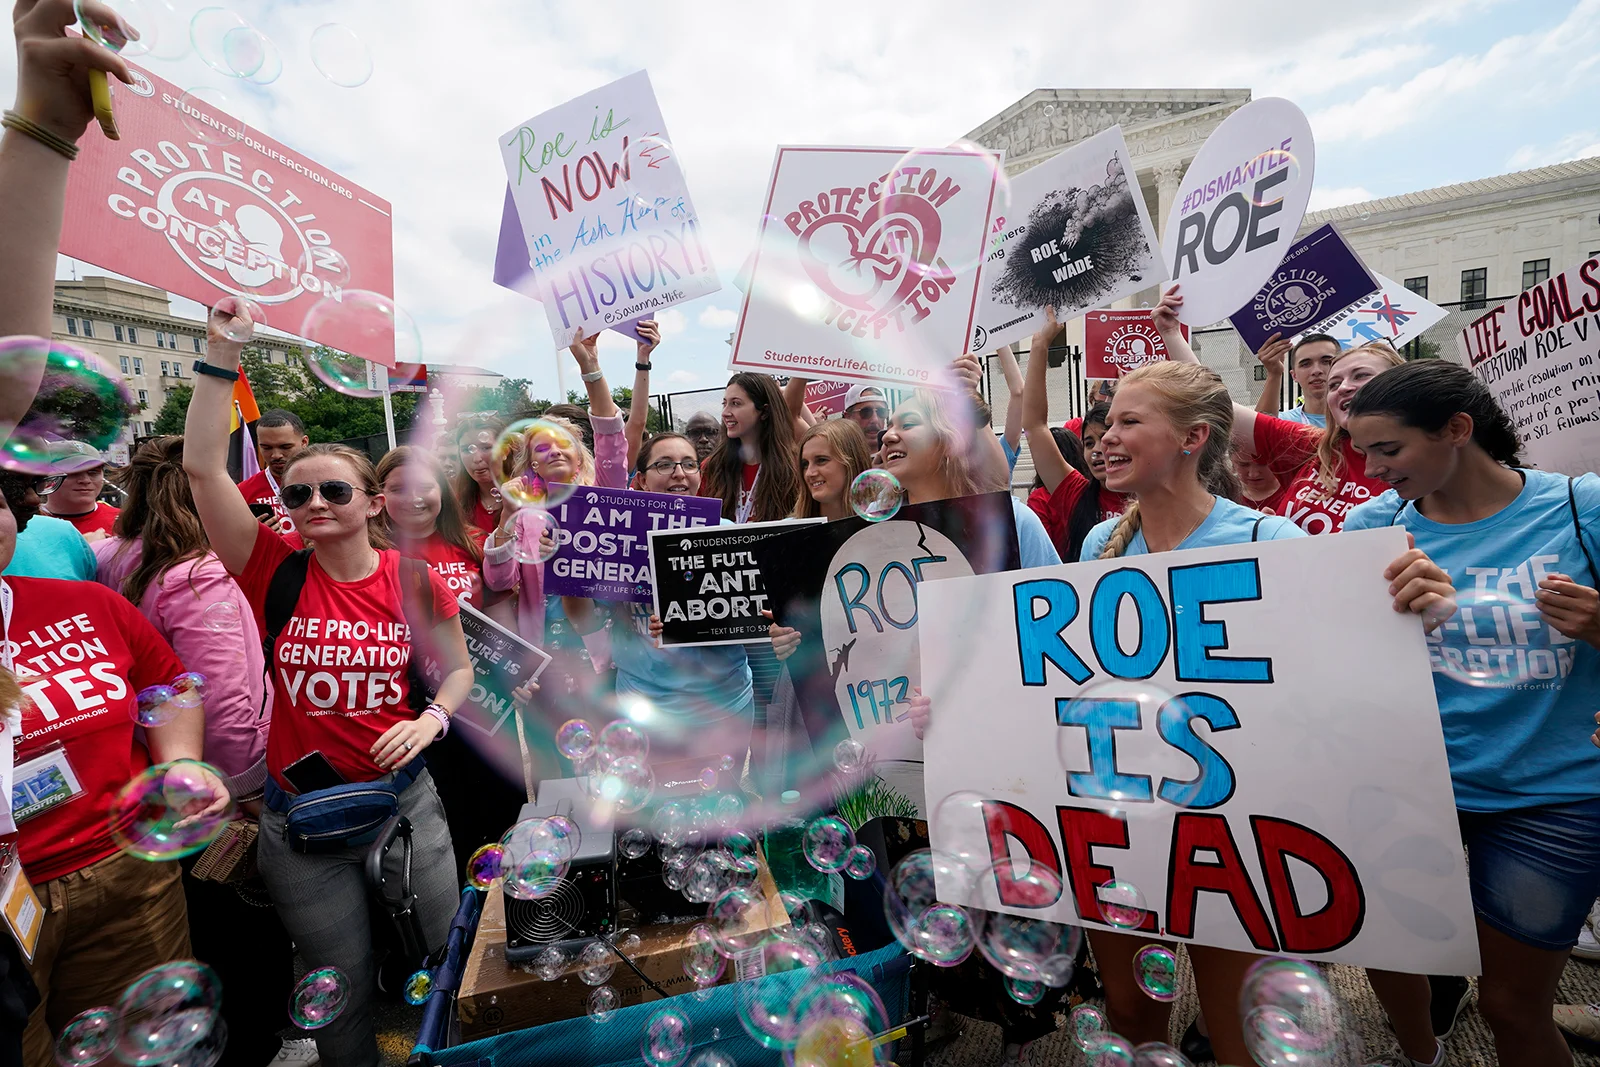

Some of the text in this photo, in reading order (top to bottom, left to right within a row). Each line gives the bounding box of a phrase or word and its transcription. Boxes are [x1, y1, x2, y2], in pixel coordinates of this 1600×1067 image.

[162, 92, 353, 200] STUDENTSFORLIFEACTION.ORG
[508, 105, 630, 186] Roe is
[541, 136, 630, 221] NOW
[1180, 137, 1293, 217] #DISMANTLE
[117, 140, 341, 273] PROTECTION
[182, 186, 230, 217] AT
[784, 167, 961, 237] PROTECTION
[535, 193, 686, 273] the Ash Heap of
[1172, 166, 1289, 282] ROE
[107, 193, 343, 303] CONCEPTION
[531, 233, 552, 252] in
[880, 230, 909, 255] AT
[1030, 239, 1060, 264] ROE
[551, 219, 708, 330] HISTORY!
[1052, 255, 1094, 284] WADE
[819, 257, 957, 339] NCEPTION
[1254, 269, 1328, 321] PROTECTION
[1262, 286, 1337, 331] CONCEPTION
[1270, 292, 1286, 309] AT
[1462, 258, 1600, 368] LIFE GOALS
[1105, 324, 1165, 353] PROTECTION
[1119, 340, 1132, 350] AT
[1475, 340, 1528, 385] OVERTURN
[1534, 325, 1572, 360] ROE
[1574, 317, 1588, 342] V
[763, 349, 929, 381] StudentsforLifeAction.org
[1103, 354, 1166, 363] CONCEPTION
[1499, 353, 1593, 408] pro-life resolution on
[1510, 385, 1562, 420] pro-choice
[1537, 401, 1551, 421] of
[1554, 405, 1563, 416] a
[1557, 410, 1600, 431] fellows
[560, 504, 707, 531] I AM THE
[600, 495, 687, 512] STUDENTS FOR LIFE
[552, 528, 648, 557] POST-
[693, 536, 737, 548] STUDENTS
[427, 561, 467, 575] -LIFE
[668, 555, 705, 571] THE
[613, 585, 629, 594] LIFE
[698, 569, 765, 594] ANT
[1466, 554, 1559, 604] THE
[664, 594, 768, 622] ABORT
[1012, 557, 1274, 686] ROE
[287, 616, 412, 642] THE PRO-LIFE
[711, 627, 727, 635] TEXT
[729, 626, 744, 634] LIFE
[746, 625, 756, 633] TO
[279, 642, 411, 668] GENERATION
[503, 659, 521, 676] IS
[280, 667, 402, 710] VOTES
[846, 675, 912, 730] 1973
[1054, 691, 1242, 809] IS
[981, 800, 1366, 953] DEAD
[836, 927, 857, 957] ckery
